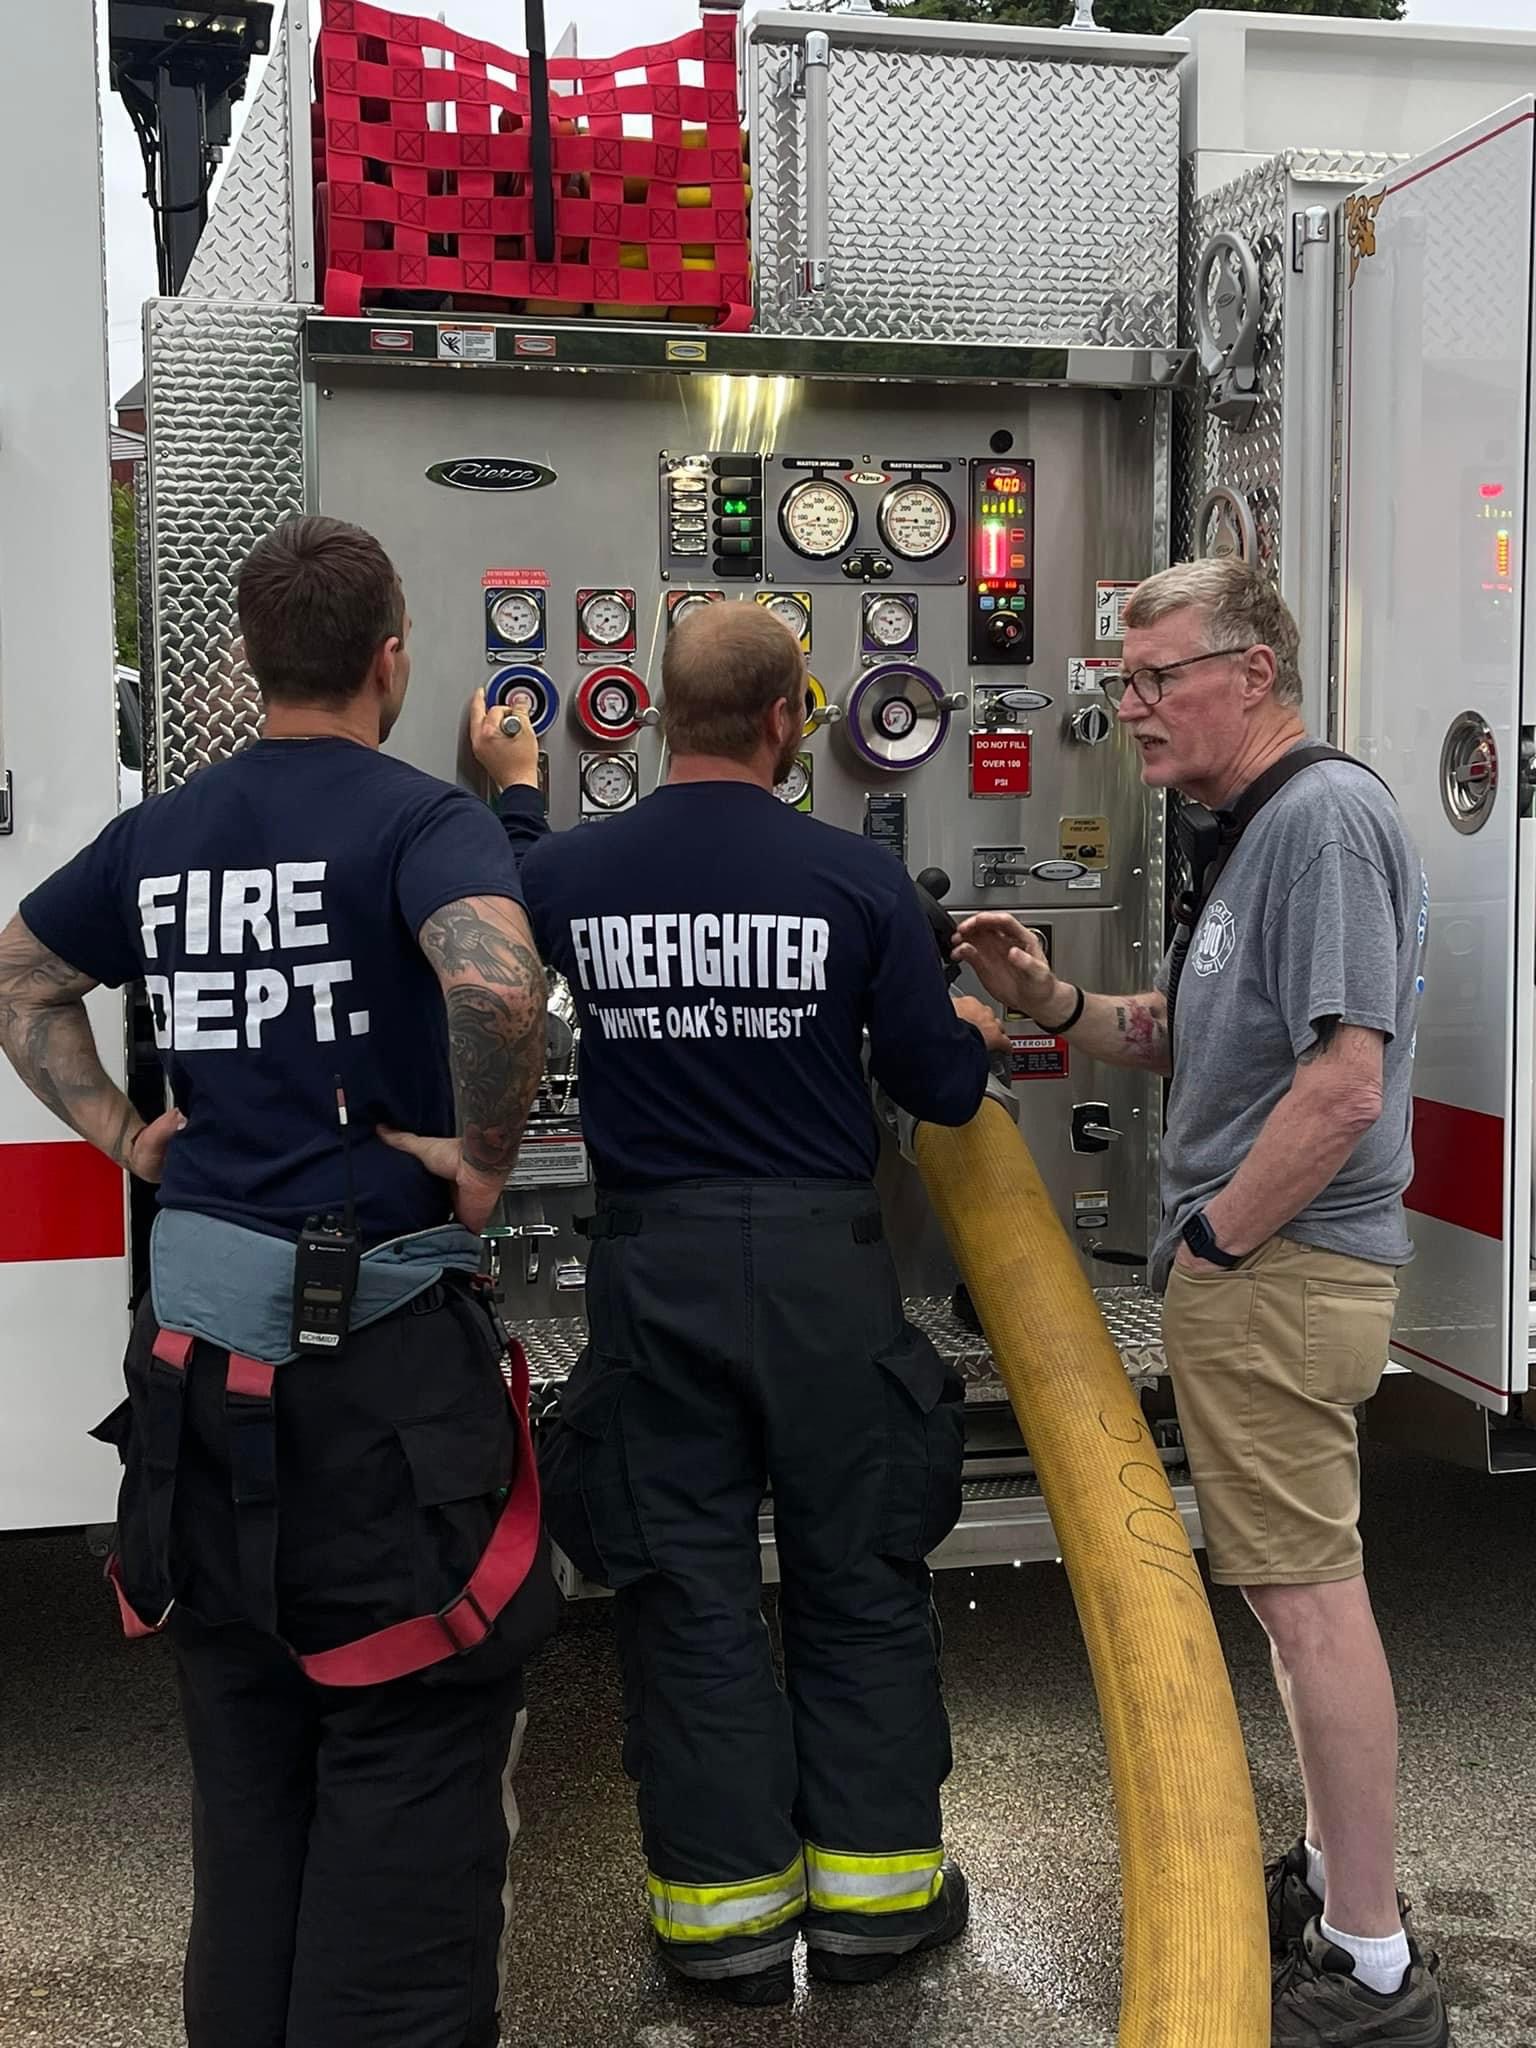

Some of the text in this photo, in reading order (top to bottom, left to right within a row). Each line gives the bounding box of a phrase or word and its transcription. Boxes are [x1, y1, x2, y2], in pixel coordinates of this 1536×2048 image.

[448, 462, 536, 481] Pierce
[855, 472, 882, 483] Pierce
[976, 740, 1028, 749] DO NOT FILL
[982, 759, 1005, 768] OVER
[994, 778, 1009, 786] PSI
[138, 861, 329, 958] FIRE
[570, 913, 830, 991] FIREFIGHTER
[144, 960, 369, 1051] DEPT.
[588, 998, 818, 1039] "WHITE OAK'S FINEST"
[1009, 1039, 1053, 1047] ATEROUS
[301, 1333, 337, 1344] SCHMIDT
